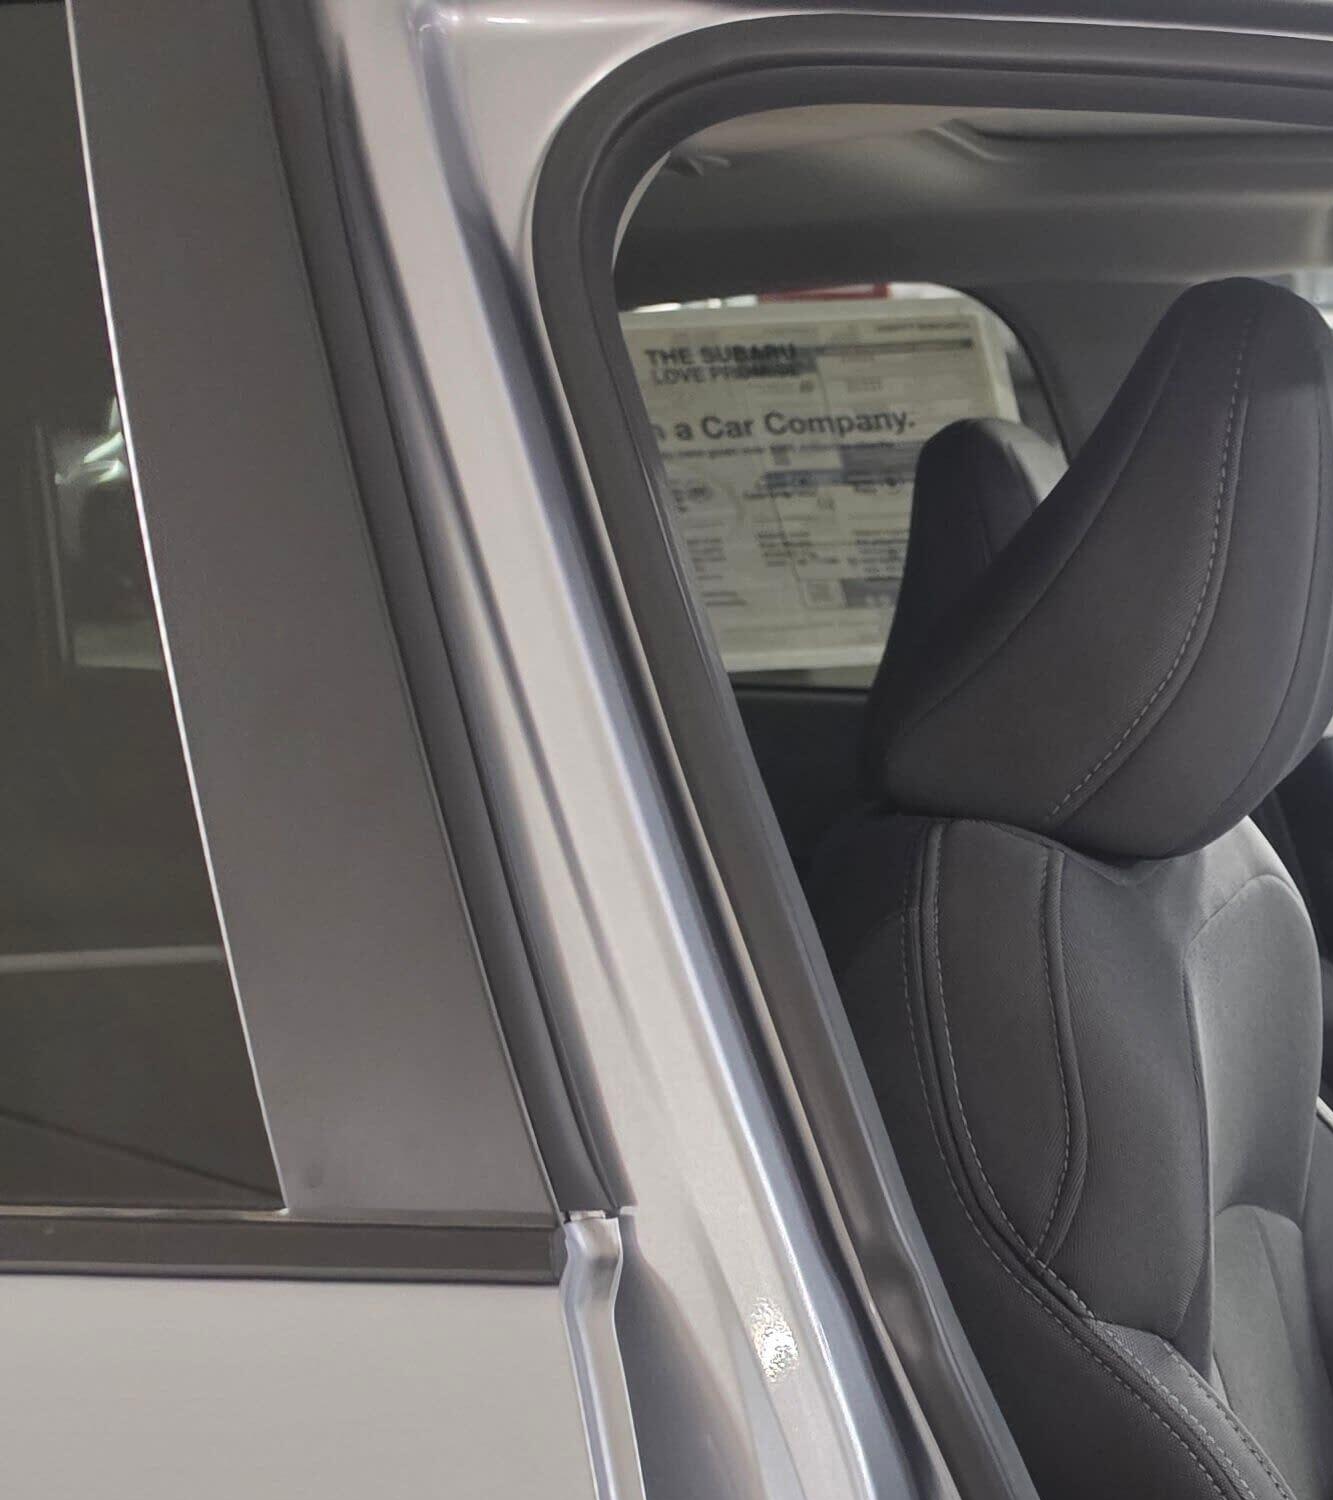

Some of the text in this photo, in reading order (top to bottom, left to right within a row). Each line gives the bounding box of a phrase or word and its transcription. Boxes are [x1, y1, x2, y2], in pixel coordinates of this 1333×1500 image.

[644, 342, 797, 366] THE SUBARU
[654, 366, 705, 385] LOVE
[675, 421, 694, 441] a
[702, 415, 755, 440] Car
[763, 410, 916, 438] Company.
